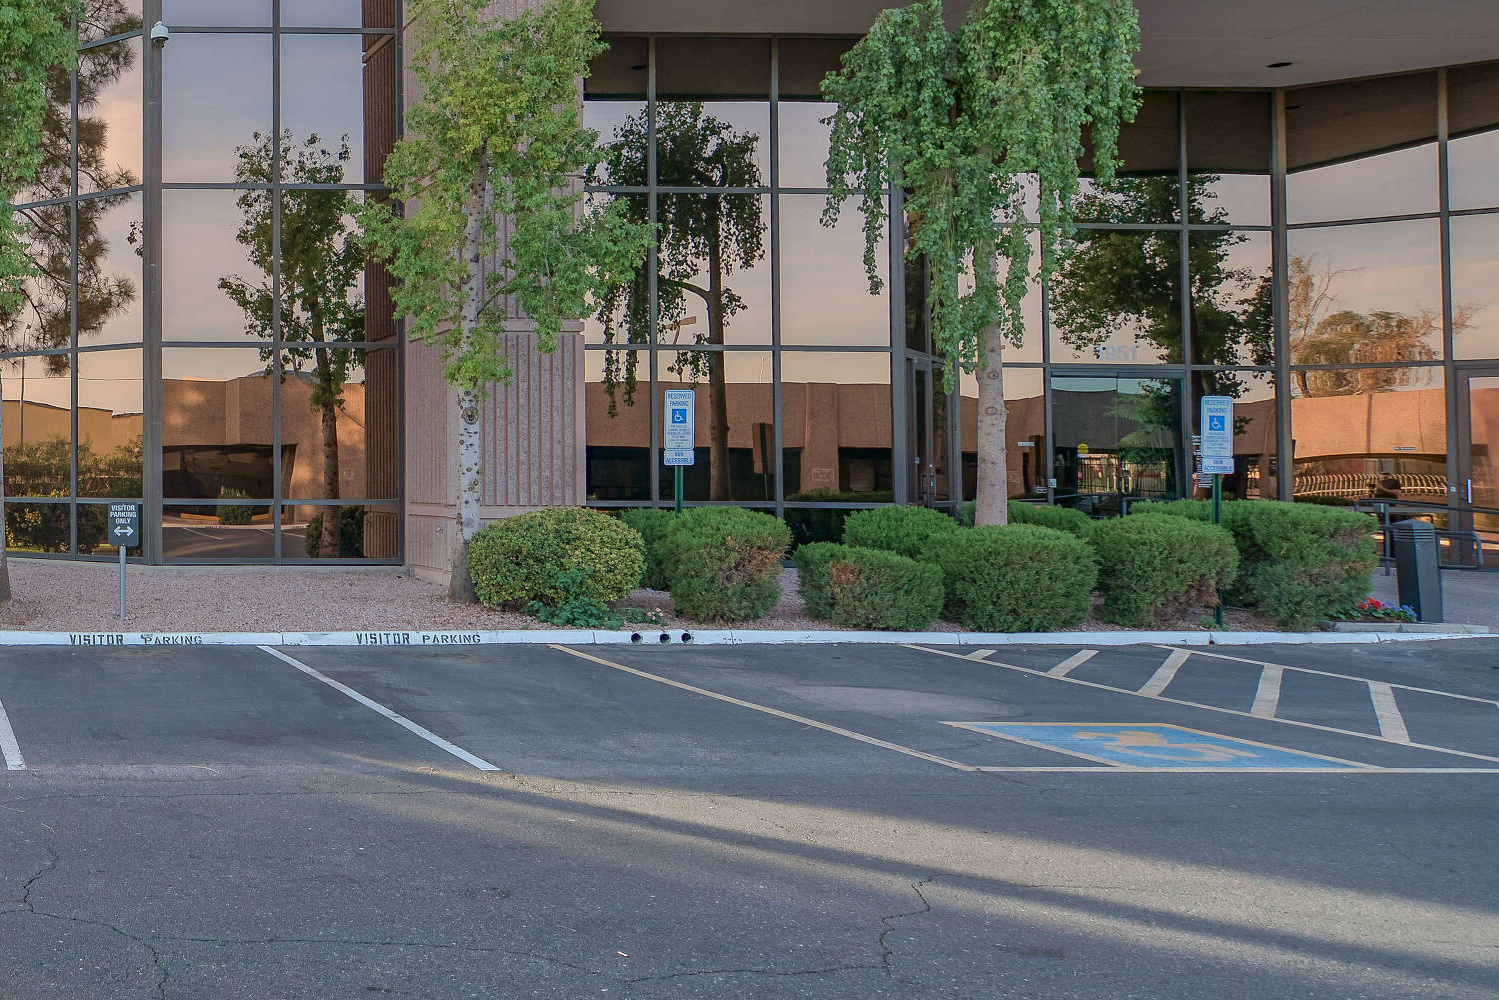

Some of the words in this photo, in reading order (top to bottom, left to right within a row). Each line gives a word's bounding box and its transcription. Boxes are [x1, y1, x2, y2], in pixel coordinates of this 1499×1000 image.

[69, 634, 124, 645] VISITOR
[144, 635, 202, 645] PARKING
[356, 632, 411, 644] VISITOR
[422, 634, 481, 643] PARKING
